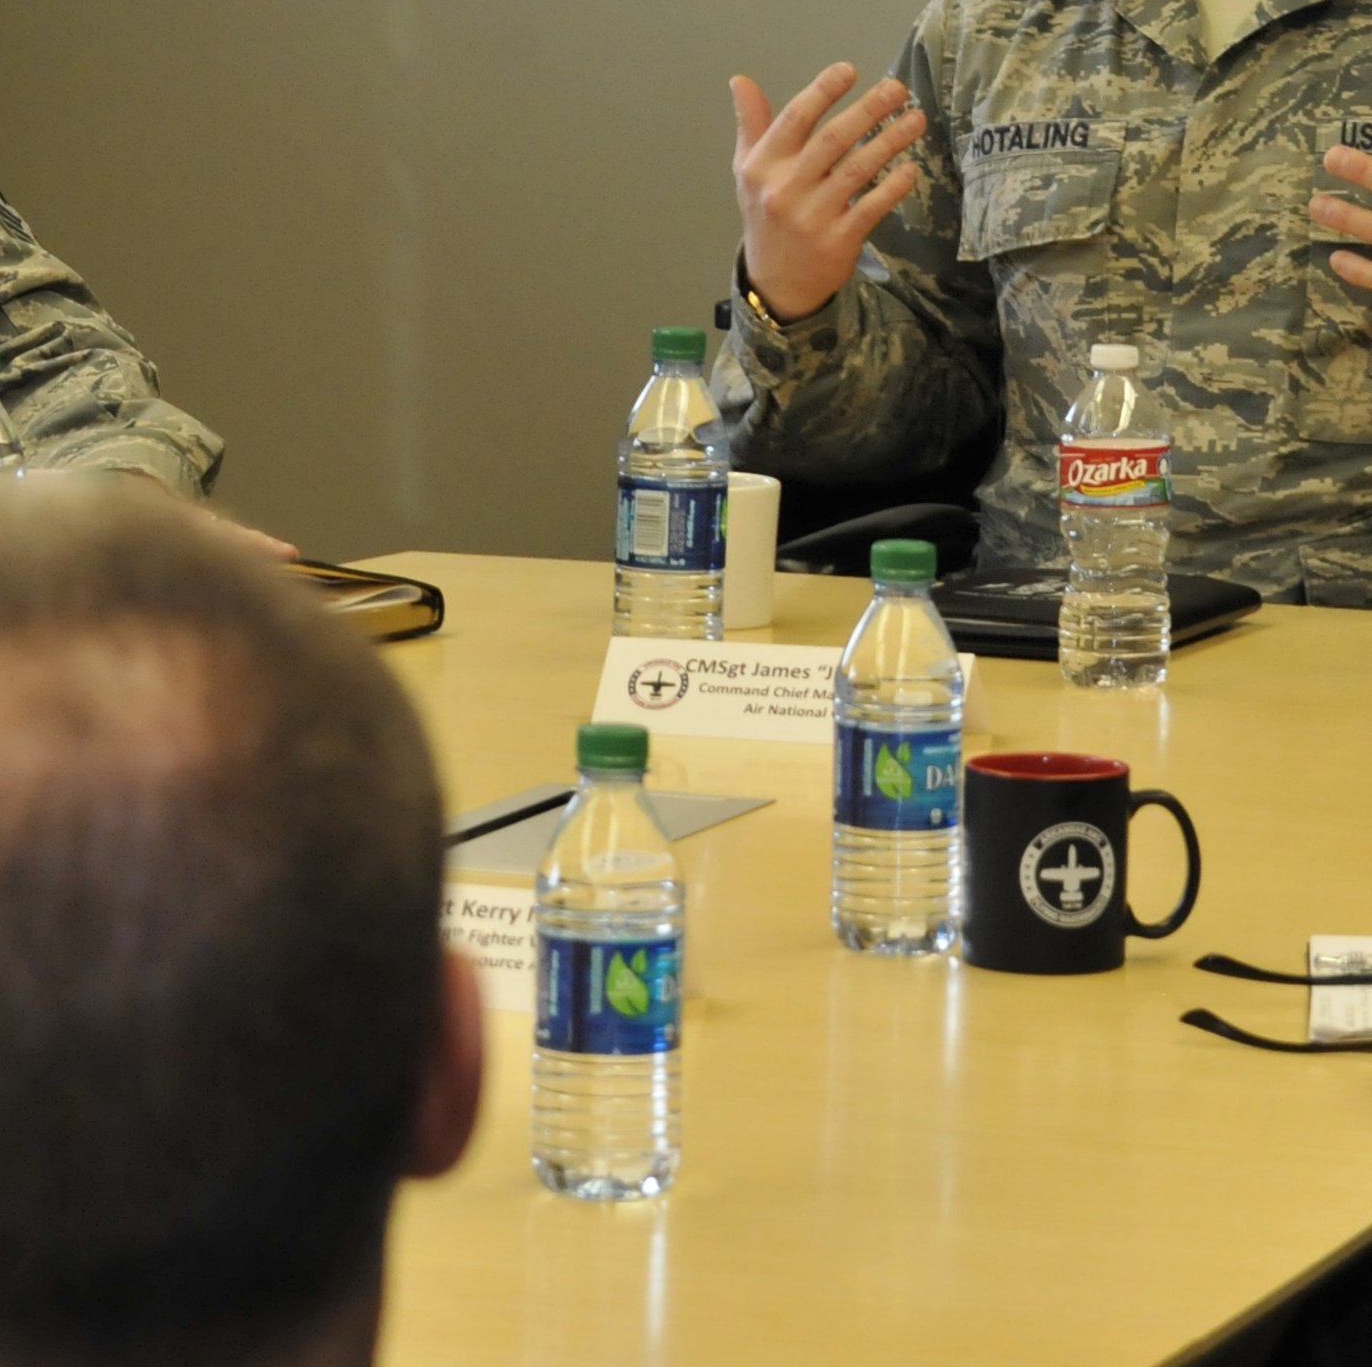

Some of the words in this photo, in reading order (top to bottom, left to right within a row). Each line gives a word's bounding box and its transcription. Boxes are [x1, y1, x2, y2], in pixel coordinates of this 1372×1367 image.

[1068, 456, 1148, 487] Ozarka
[686, 658, 747, 679] CMSgt
[750, 661, 811, 680] James
[698, 682, 770, 698] Command
[773, 686, 810, 699] Chief
[743, 703, 765, 715] Air
[767, 704, 828, 719] National
[461, 898, 522, 926] Kerry
[468, 929, 525, 947] Fighter
